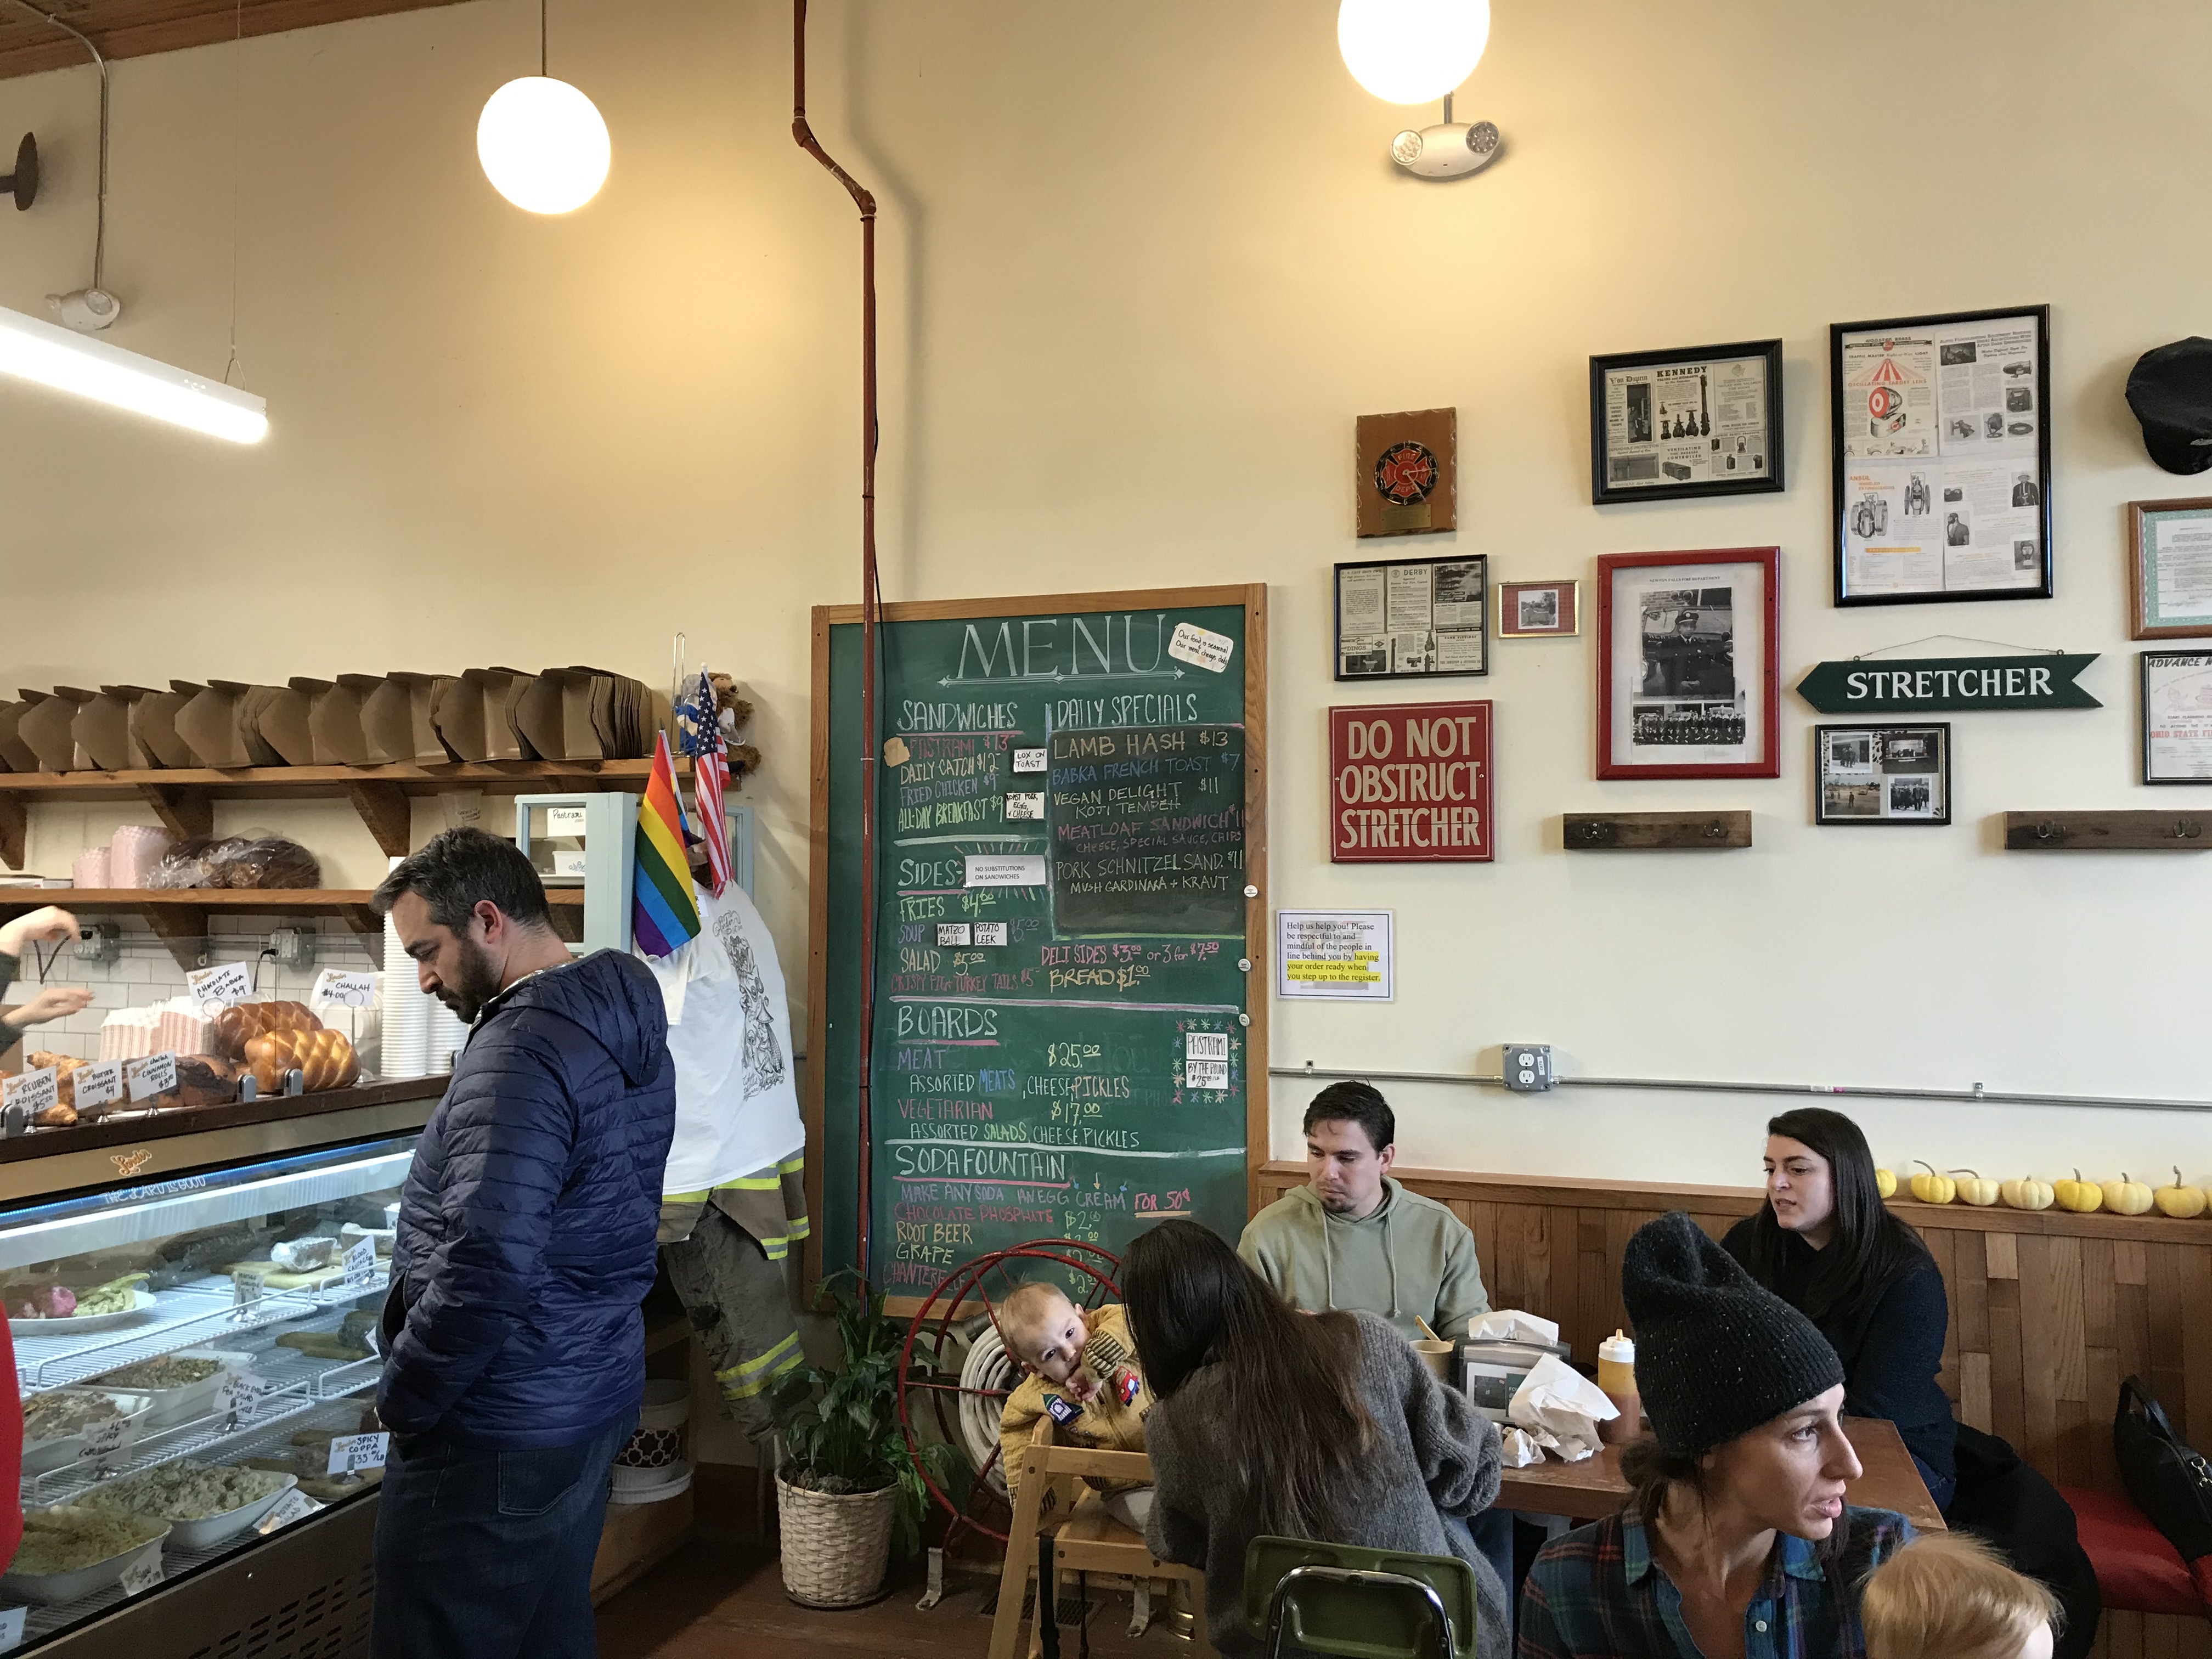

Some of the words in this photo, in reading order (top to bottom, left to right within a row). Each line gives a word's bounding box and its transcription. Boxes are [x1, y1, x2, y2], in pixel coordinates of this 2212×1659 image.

[1657, 366, 1707, 377] KENNEDY
[956, 613, 1166, 679] MENU
[2149, 657, 2202, 668] ADVANCE
[1847, 667, 2054, 699] STRETCHER
[896, 700, 1018, 731] SANDWICHES
[1111, 693, 1198, 726] SPECIALS
[1054, 736, 1115, 760] LAMB
[1126, 731, 1186, 755] HASH
[1199, 730, 1228, 747] $13
[1348, 719, 1393, 759] DO
[1406, 716, 1476, 758] NOT
[2173, 730, 2198, 738] STATE
[909, 737, 975, 760] PASTRAMI
[900, 760, 935, 785] DAILY
[939, 756, 975, 777] CATCH
[1052, 765, 1097, 786] BABKA
[1103, 759, 1159, 781] FRENCH
[1165, 756, 1212, 774] TOAST
[1220, 752, 1241, 771] $7
[899, 786, 932, 808] FRIED
[935, 776, 979, 799] CHICKEN
[1054, 788, 1102, 806] VEGAN
[1109, 782, 1182, 802] DELIGHT
[1198, 776, 1218, 794] $11
[1340, 761, 1481, 804] OBSTRUCT
[935, 798, 989, 828] BREAKFAST
[990, 794, 1004, 823] $9
[1013, 810, 1034, 819] CHEESE
[1076, 805, 1110, 819] KOJI
[1116, 799, 1181, 814] TEMPEH
[1058, 822, 1143, 842] MEATLOAF
[1149, 811, 1228, 832] SANDWICH
[1340, 806, 1481, 849] STRETCHER
[1123, 834, 1168, 849] SPECIAL
[1211, 831, 1242, 843] CHIPS
[898, 858, 958, 887] SIDES
[1056, 861, 1091, 881] PORK
[1097, 854, 1181, 877] SCHNITZEL
[1070, 881, 1102, 894] MUSH
[1182, 876, 1229, 891] KRAUT
[899, 896, 945, 922] FRIES
[898, 924, 926, 944] SOUP
[938, 925, 966, 936] MATZO
[975, 923, 1000, 933] POTATO
[1286, 922, 1304, 931] Help
[1316, 922, 1331, 931] help
[1333, 923, 1349, 932] you!
[1297, 933, 1331, 941] respectful
[939, 936, 961, 946] BALL
[977, 934, 996, 944] LEEK
[1339, 943, 1363, 952] people
[900, 947, 941, 974] SALAD
[1041, 945, 1071, 967] DELI
[1074, 944, 1107, 964] SIDES
[1147, 949, 1161, 961] or
[1161, 943, 1172, 963] 3
[1173, 946, 1188, 961] for
[1344, 953, 1352, 961] by
[1354, 953, 1379, 962] having
[1302, 973, 1317, 981] step
[1351, 974, 1381, 983] register.
[1325, 963, 1346, 972] ready
[212, 974, 244, 997] BABKA
[336, 982, 371, 992] CHALLAH
[1049, 967, 1115, 994] BREAD
[898, 1005, 998, 1039] BOARDS
[1187, 1034, 1226, 1056] PASTRAMI
[142, 1060, 172, 1079] CINNAMON
[898, 1047, 947, 1070] MEAT
[1188, 1062, 1197, 1074] BY
[1199, 1063, 1209, 1075] THE
[1210, 1063, 1227, 1075] POUND
[21, 1073, 52, 1094] REUBEN
[82, 1075, 116, 1094] CROISSANT
[150, 1070, 168, 1082] ROLLS
[910, 1074, 975, 1093] ASSORTED
[979, 1068, 1015, 1093] MEATS
[898, 1098, 994, 1121] VEGETARIAN
[911, 1123, 978, 1141] ASSORTED
[1082, 1127, 1140, 1148] PICKLES
[901, 1183, 939, 1203] MAKE
[945, 1182, 973, 1203] ANY
[974, 1185, 1004, 1201] SODA
[1037, 1190, 1069, 1205] EGG
[1076, 1190, 1126, 1211] CREAM
[1134, 1193, 1158, 1211] FOR
[894, 1202, 975, 1222] CHOCOLATE
[979, 1204, 1054, 1223] PHOSPHATE
[896, 1220, 929, 1243] ROOT
[933, 1223, 973, 1245] BEER
[896, 1243, 955, 1265] GRAPE
[349, 1443, 378, 1453] COPPA
[357, 1434, 380, 1446] SPICY
